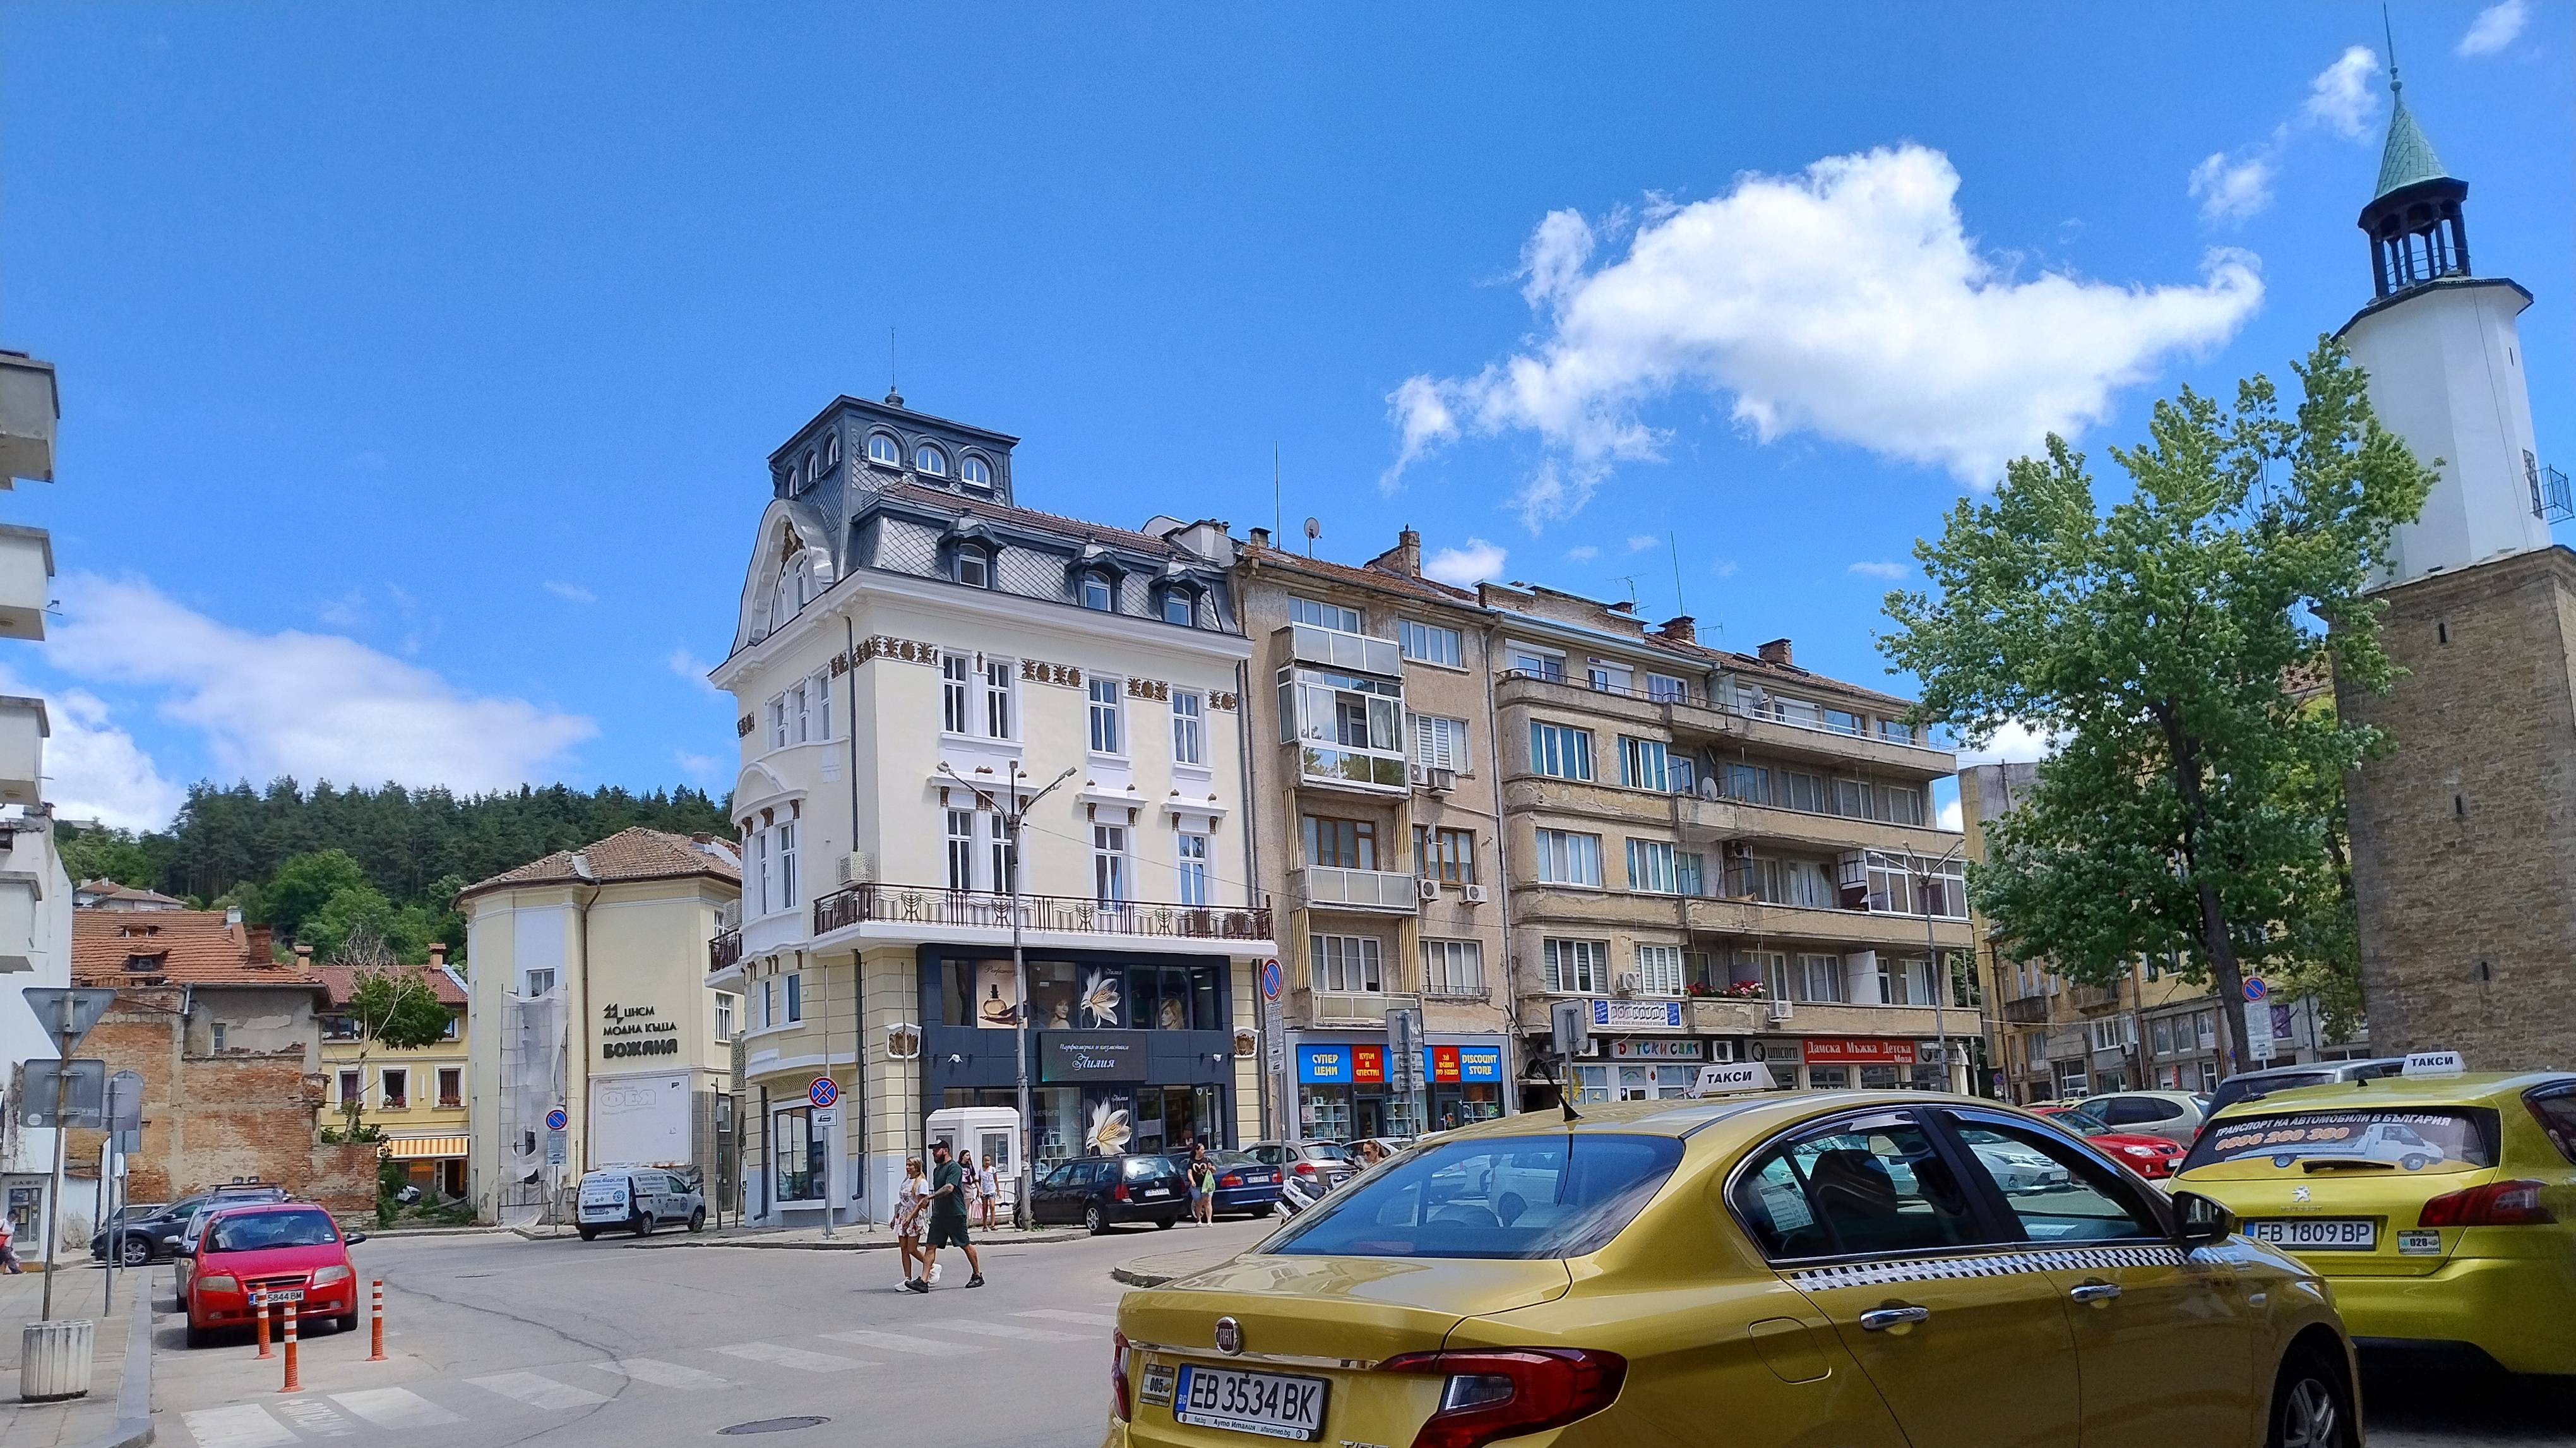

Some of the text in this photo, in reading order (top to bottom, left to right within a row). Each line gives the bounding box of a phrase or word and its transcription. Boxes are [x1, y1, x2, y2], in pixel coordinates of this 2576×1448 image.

[603, 1021, 677, 1036] МОДНА КЪЩА
[1768, 1044, 1798, 1059] unicorn
[1808, 1041, 1912, 1055] Дамска Мъжка Детска
[1072, 1053, 1115, 1071] Лилия
[1312, 1054, 1339, 1064] СУПЕР
[1462, 1054, 1498, 1063] DISCOUNT
[2411, 1056, 2454, 1067] ТАКСИ
[1315, 1066, 1338, 1076] ЦЕНИ
[1469, 1065, 1493, 1075] STORE
[1707, 1071, 1752, 1084] ТАКСИ
[2215, 1113, 2452, 1138] ТРАНСПОРТ НА АВТОМОБИЛИ В БЪЛГАРИЯ
[2257, 1223, 2370, 1242] EB 1809 BP
[268, 1293, 289, 1301] 5844
[1219, 1327, 1234, 1345] FIAT
[1149, 1377, 1164, 1393] 005
[1178, 1394, 1187, 1404] BG
[1190, 1373, 1317, 1423] EB 3534 BK
[1231, 1420, 1256, 1431] Италия
